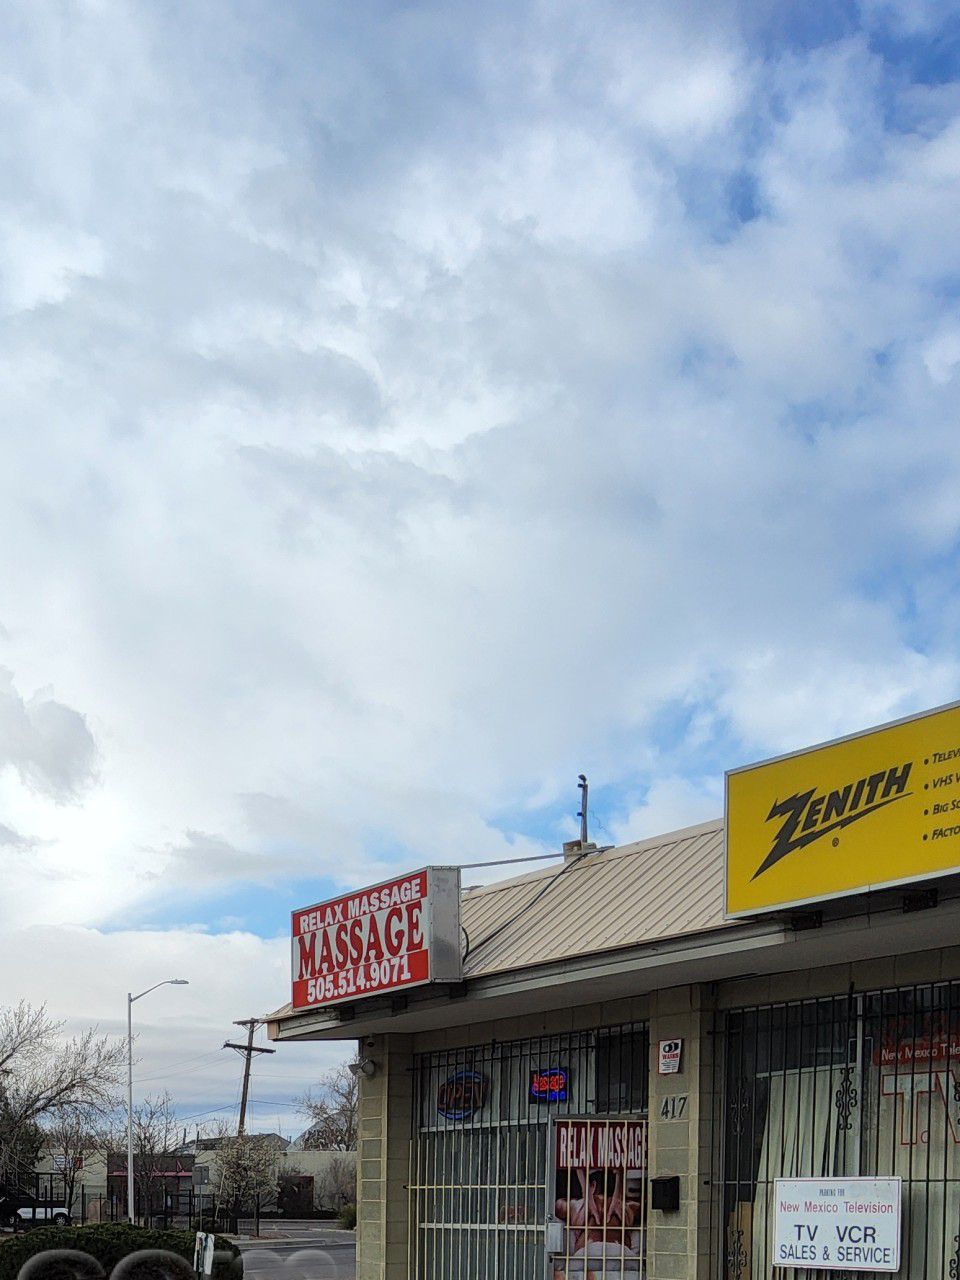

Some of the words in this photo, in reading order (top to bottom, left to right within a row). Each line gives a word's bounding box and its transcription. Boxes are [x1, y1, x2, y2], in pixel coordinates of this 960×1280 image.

[933, 774, 953, 788] VHS
[933, 803, 948, 815] BIG
[749, 762, 914, 883] ZENITH
[300, 903, 344, 934] RELAX
[347, 878, 421, 919] MASSAGE
[298, 900, 424, 980] MASSAGE
[307, 954, 411, 1003] 505.514.9071
[661, 1096, 688, 1119] 417
[780, 1201, 800, 1213] New
[804, 1201, 838, 1213] Mexico
[843, 1201, 893, 1214] Television
[794, 1224, 818, 1242] TV
[836, 1225, 876, 1243] VCR
[780, 1244, 817, 1261] SALES
[822, 1246, 830, 1261] &
[837, 1246, 891, 1263] SERVICE
